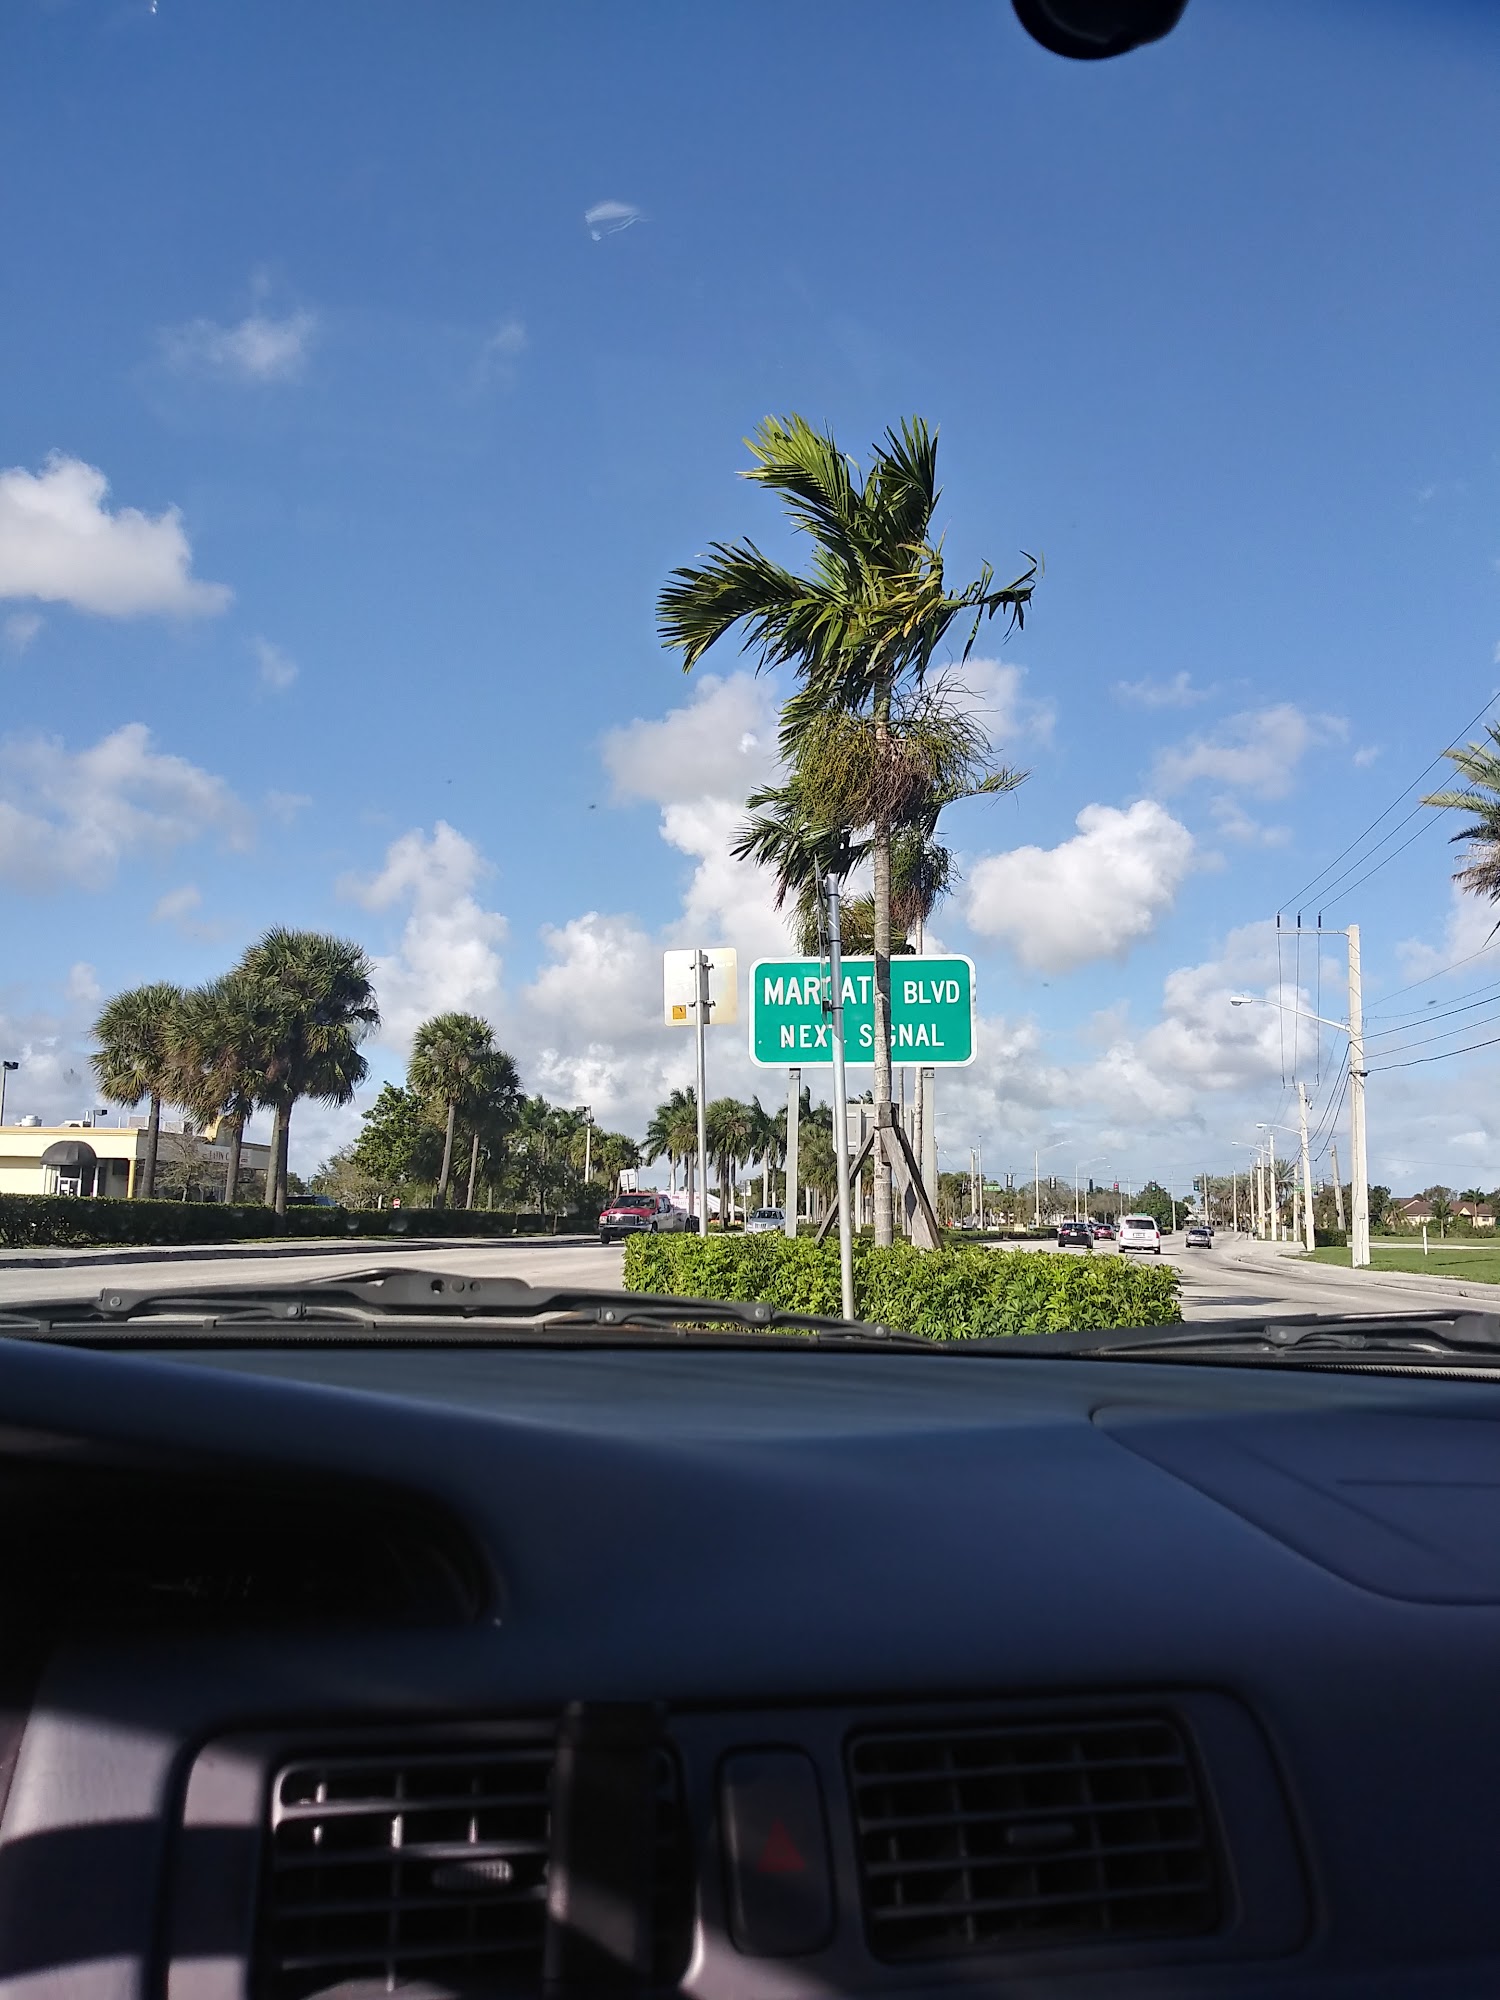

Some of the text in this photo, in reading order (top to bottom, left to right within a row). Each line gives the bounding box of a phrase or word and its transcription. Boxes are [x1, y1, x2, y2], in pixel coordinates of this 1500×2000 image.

[764, 976, 960, 1005] MARAT BLVD
[780, 1023, 945, 1048] NEX SNAL
